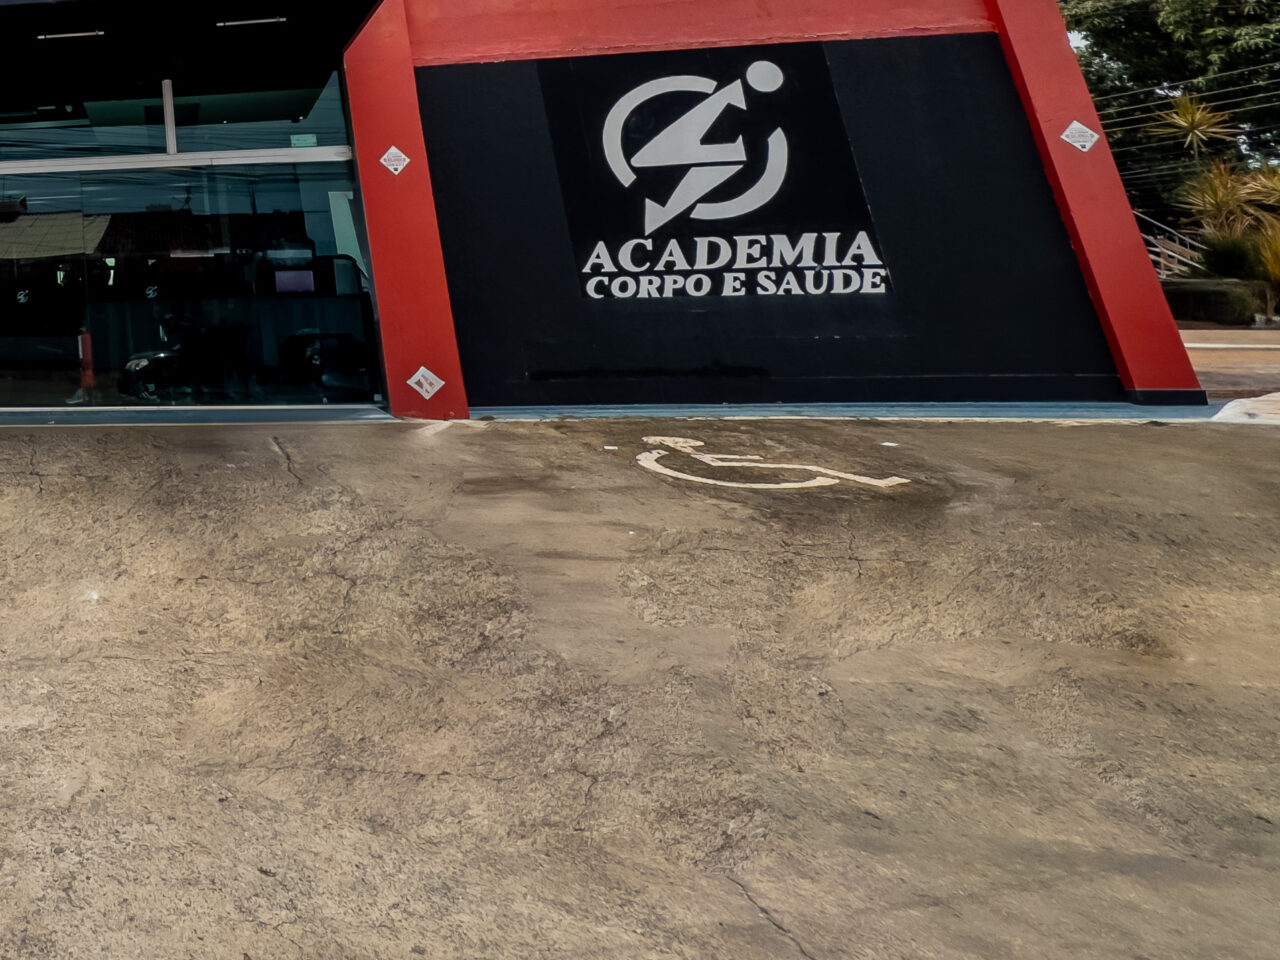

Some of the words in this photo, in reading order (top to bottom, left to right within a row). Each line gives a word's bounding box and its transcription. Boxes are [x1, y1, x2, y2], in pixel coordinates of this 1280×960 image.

[582, 231, 883, 273] ACADEMIA
[586, 273, 712, 299] CORPO
[721, 272, 747, 297] E
